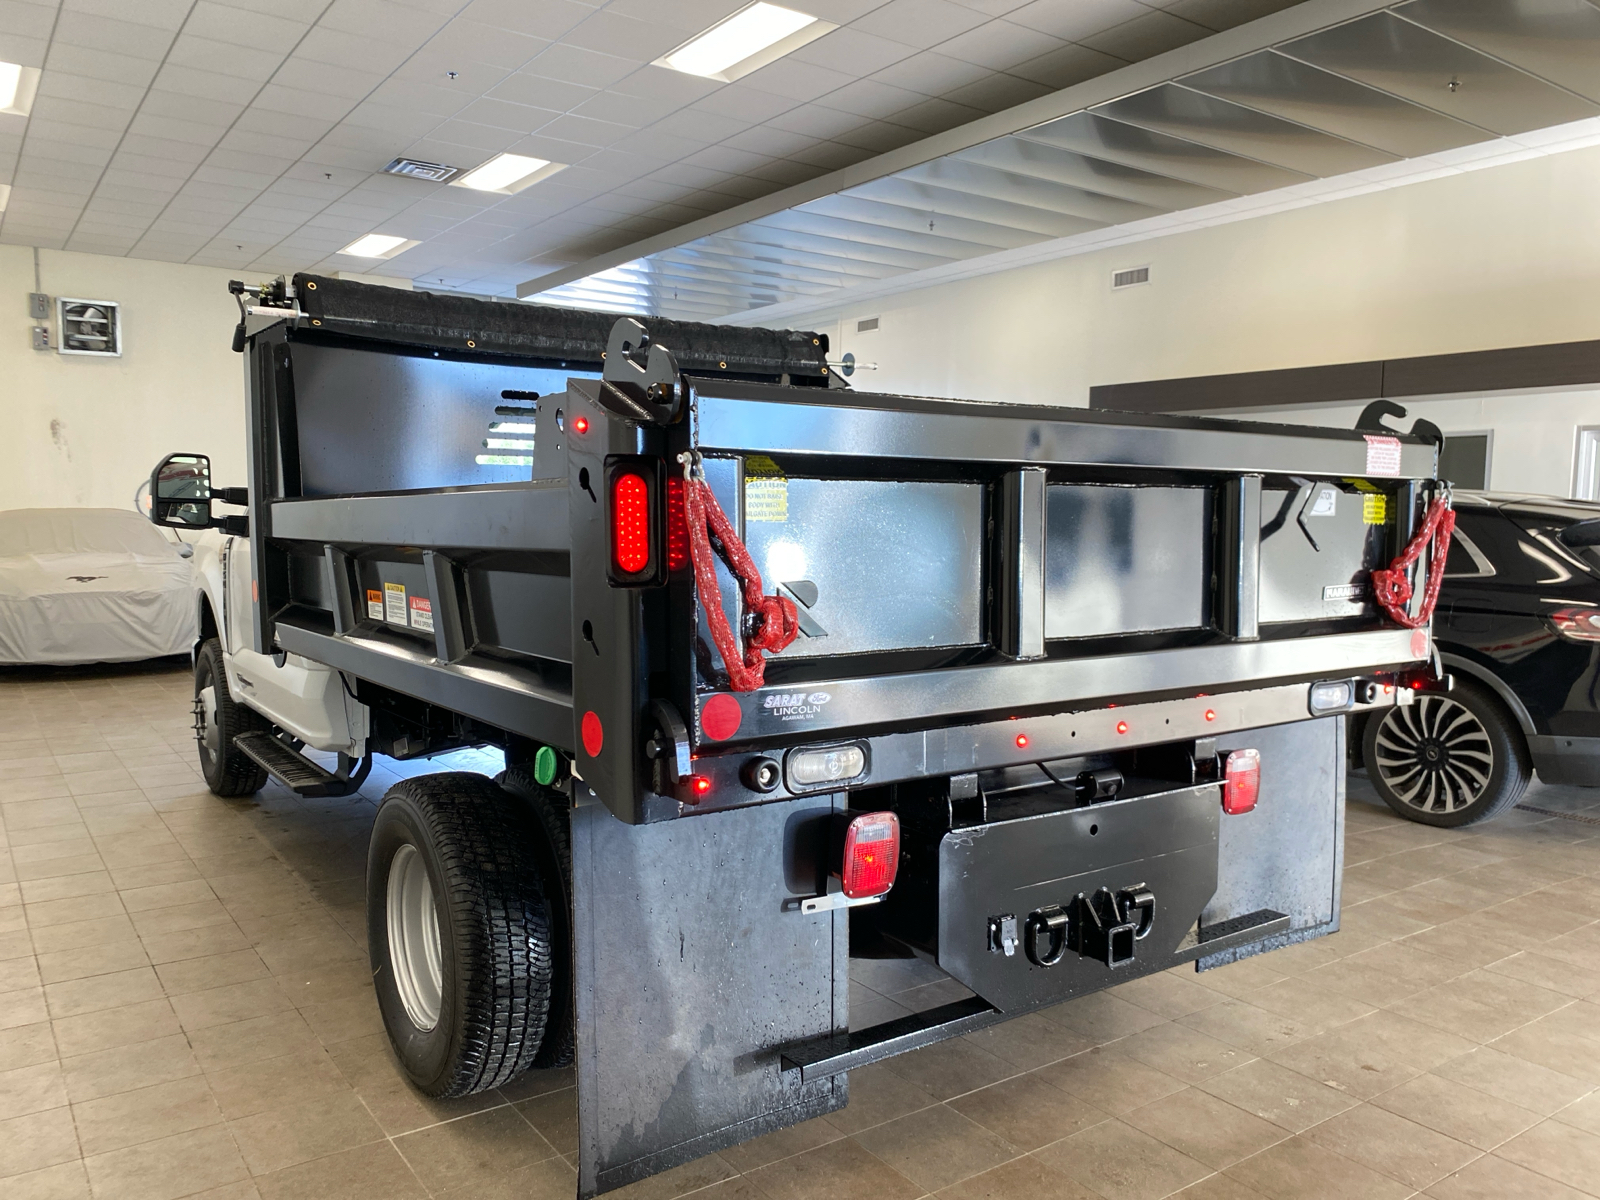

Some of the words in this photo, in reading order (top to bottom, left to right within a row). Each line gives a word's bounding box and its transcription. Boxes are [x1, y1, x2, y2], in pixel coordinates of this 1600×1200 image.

[747, 481, 787, 489] AUTION
[764, 693, 806, 709] SARAT
[773, 705, 821, 716] LINCOLN
